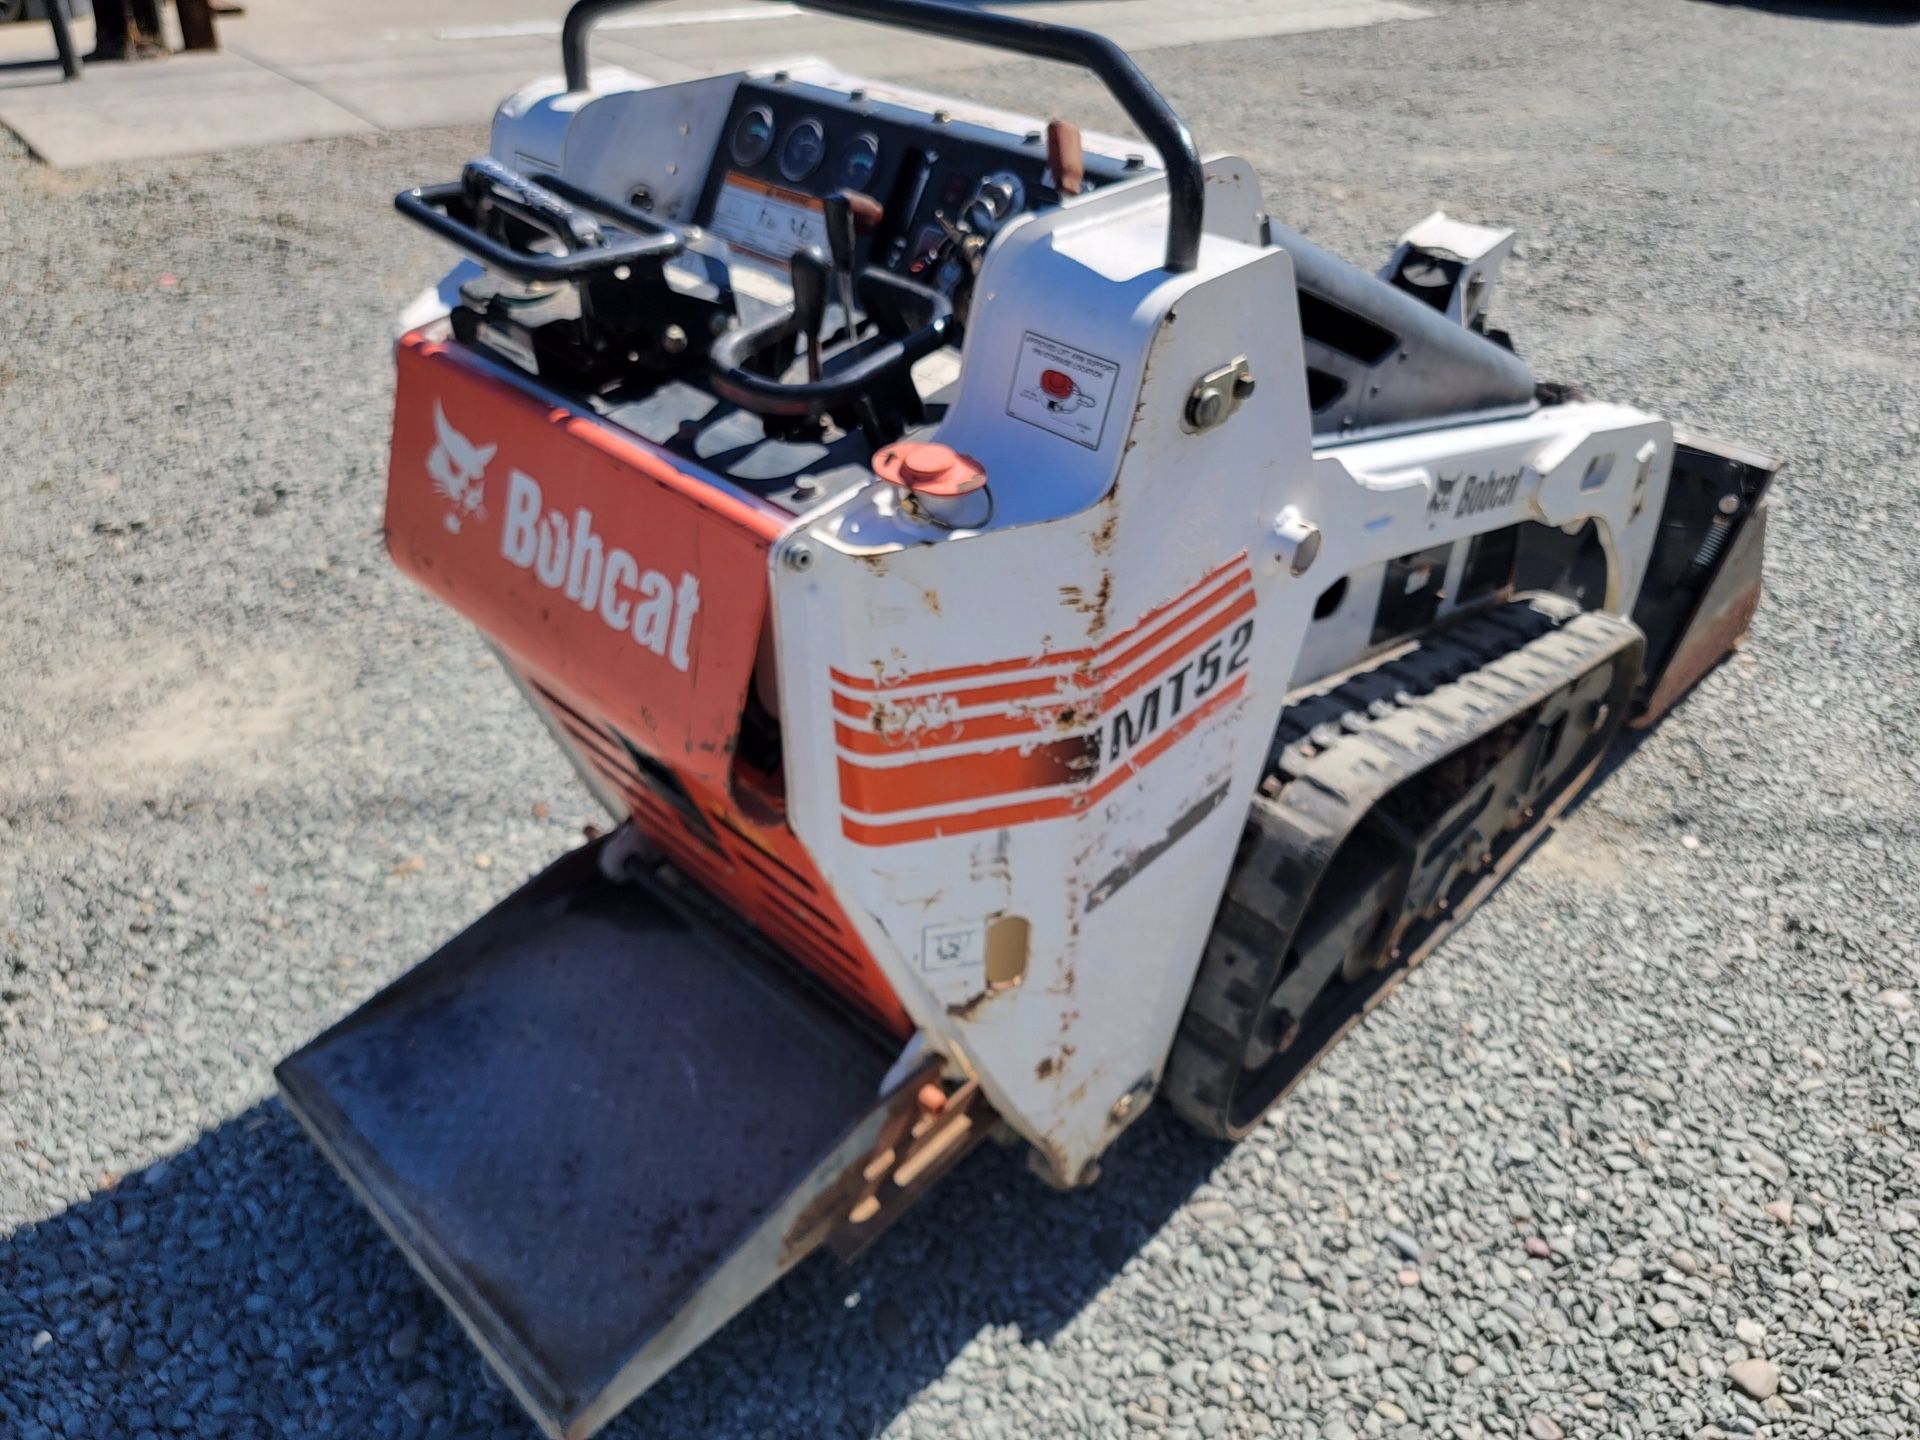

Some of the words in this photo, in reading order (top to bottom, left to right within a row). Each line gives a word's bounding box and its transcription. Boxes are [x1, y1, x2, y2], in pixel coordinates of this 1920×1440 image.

[1454, 466, 1524, 519] Bobcat
[501, 468, 701, 673] Bobcat
[1109, 618, 1255, 763] MT52
